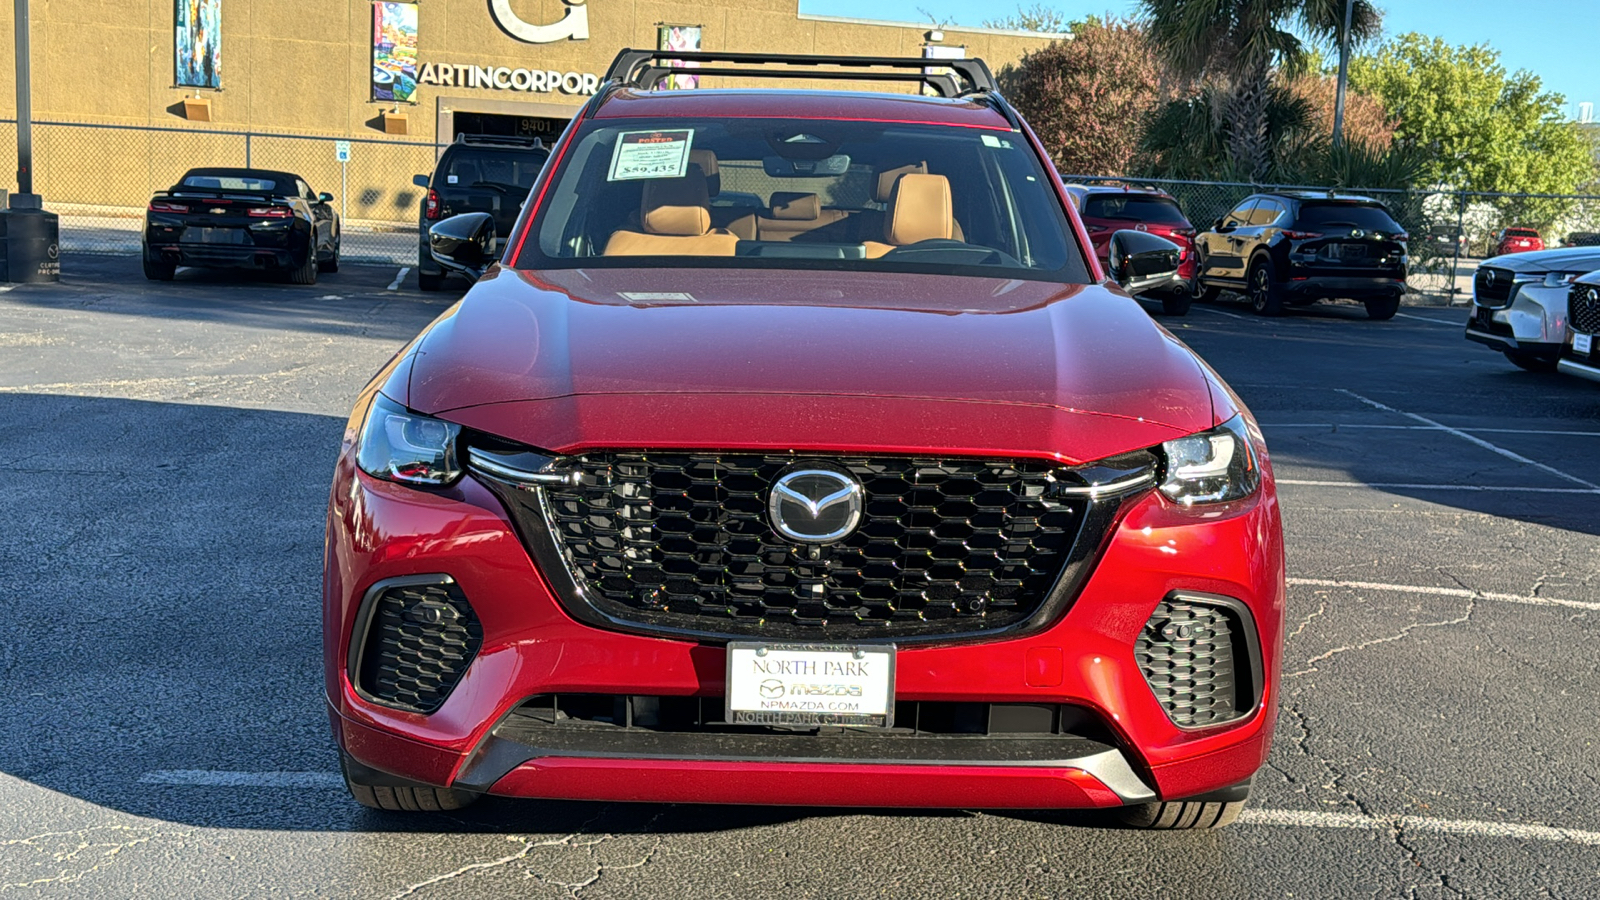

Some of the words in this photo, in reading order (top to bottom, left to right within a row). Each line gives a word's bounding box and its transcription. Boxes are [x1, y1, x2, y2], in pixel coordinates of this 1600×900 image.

[419, 62, 604, 95] ARTINCORPOR
[521, 119, 551, 132] 9401
[623, 164, 676, 174] $59,435
[752, 659, 816, 675] NORTH
[824, 661, 870, 676] PARK
[790, 683, 863, 697] mazda
[760, 701, 859, 711] NPMAZDACOM
[735, 712, 781, 723] NORTH
[786, 714, 821, 724] PARK
